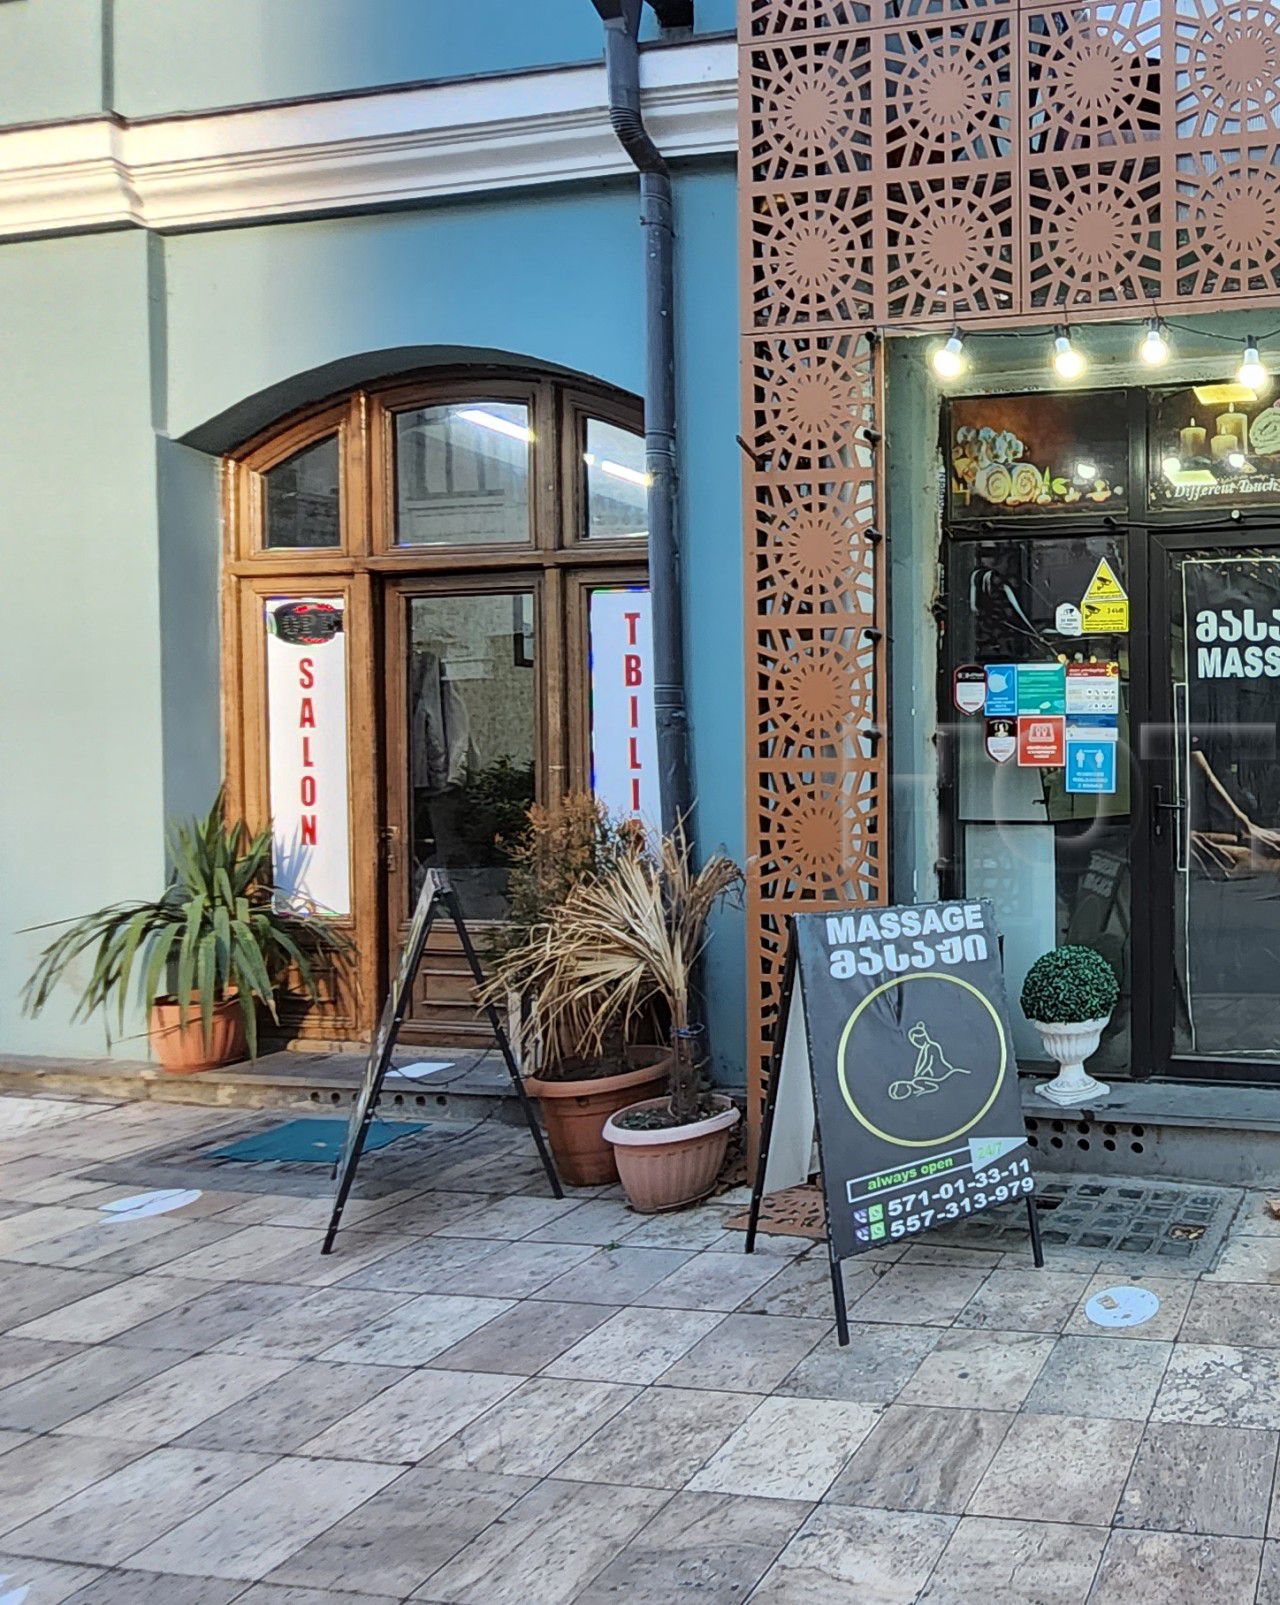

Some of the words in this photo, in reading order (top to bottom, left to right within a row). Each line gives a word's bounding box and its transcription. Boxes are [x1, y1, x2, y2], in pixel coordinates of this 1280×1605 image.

[298, 657, 318, 847] SALON
[623, 612, 645, 848] TBILI
[825, 904, 985, 946] MASSAGE
[829, 932, 988, 980] მასაჟი
[867, 1167, 918, 1191] always
[920, 1156, 954, 1176] open
[887, 1158, 1030, 1217] 571-01-33-11
[890, 1176, 1035, 1238] 557-313-979
